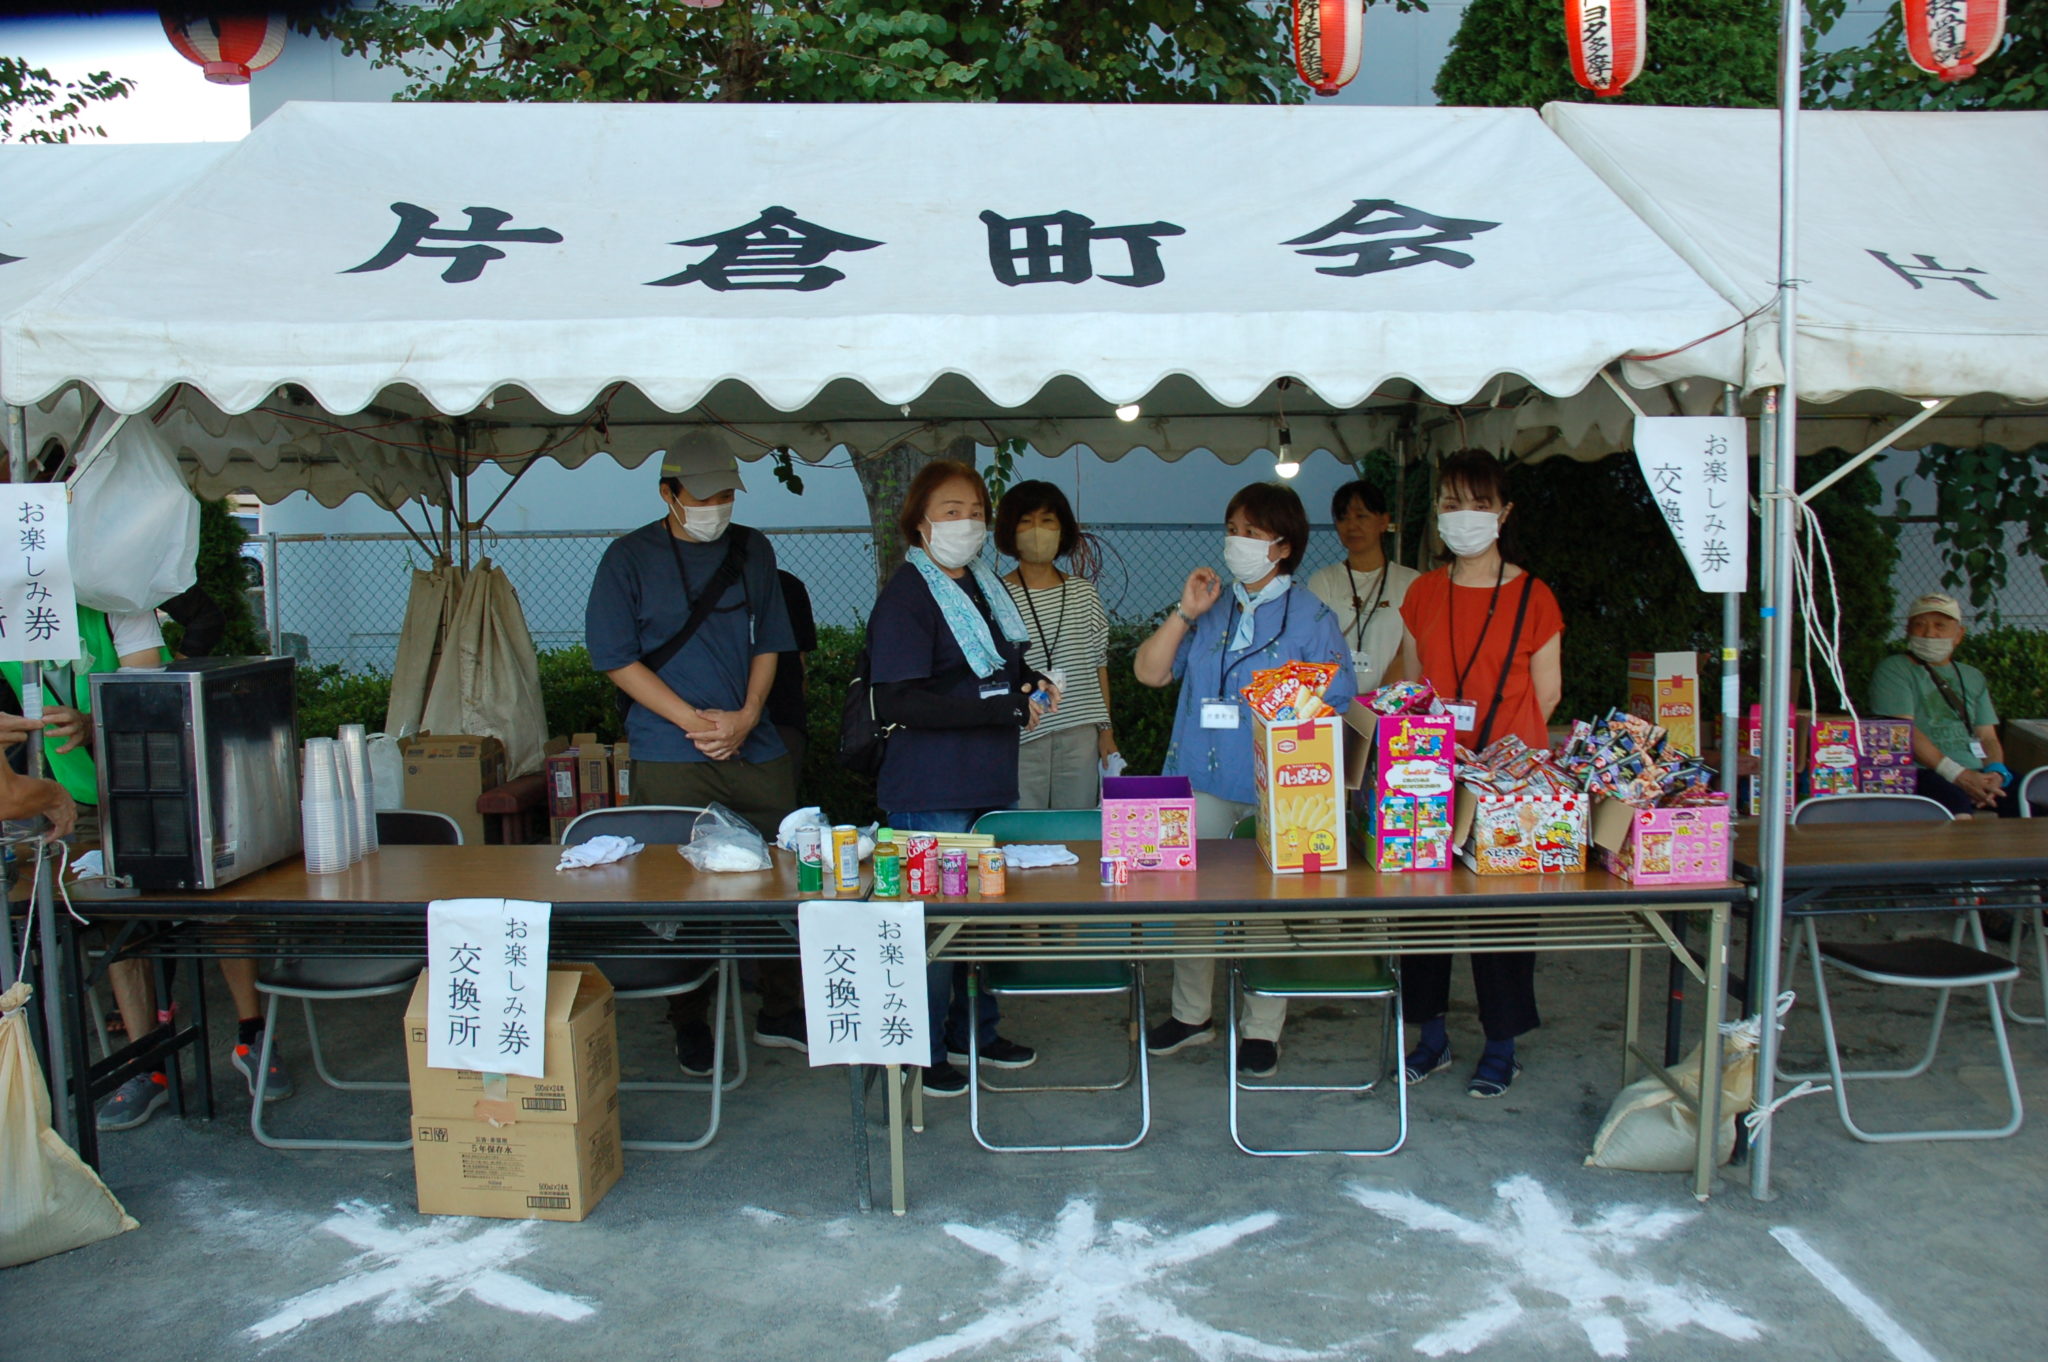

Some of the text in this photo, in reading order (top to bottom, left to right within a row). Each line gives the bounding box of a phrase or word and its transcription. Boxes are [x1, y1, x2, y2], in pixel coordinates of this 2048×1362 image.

[336, 200, 1501, 292] 片倉町会
[1652, 463, 1687, 549] 交換
[1701, 434, 1731, 573] お楽しみ券
[18, 502, 60, 641] お楽しみ券
[1278, 767, 1332, 786] ハッピーターン
[448, 943, 481, 1048] 交換所
[499, 918, 530, 1055] お楽しみ券
[823, 945, 860, 1044] 交換所
[878, 920, 913, 1047] お楽しみ券
